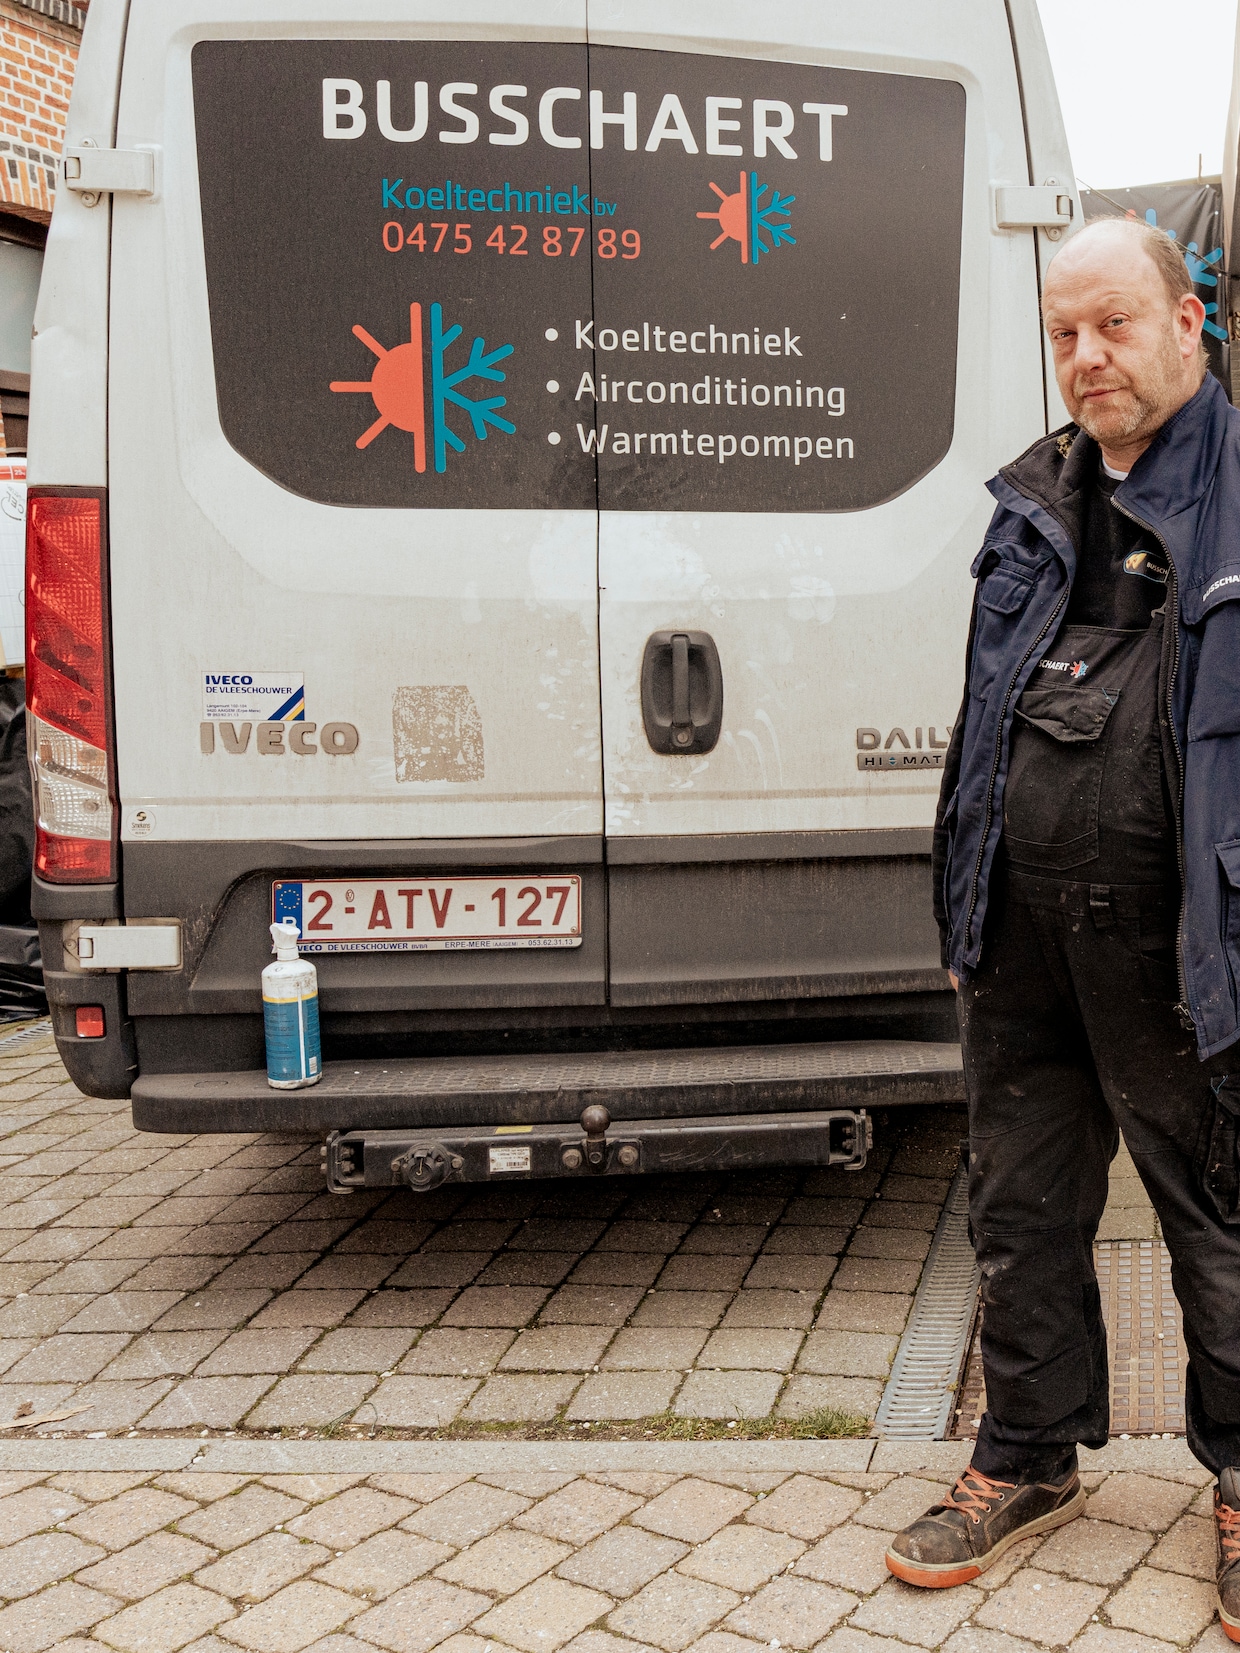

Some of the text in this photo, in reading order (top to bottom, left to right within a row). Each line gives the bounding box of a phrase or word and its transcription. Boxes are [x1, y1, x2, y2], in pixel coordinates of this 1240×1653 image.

[321, 77, 849, 162] BUSSCHAERT
[382, 177, 617, 217] Koeltechniek bv
[382, 220, 642, 260] 0475 42 87 89
[575, 320, 803, 358] Koeltechniek
[575, 372, 846, 417] Airconditioning
[576, 423, 855, 465] Warmtepompen
[1146, 561, 1168, 575] BUSSCH
[205, 675, 253, 685] IVECO
[1039, 659, 1070, 671] SCHAERT
[206, 686, 292, 694] DE VLEESCHOUWER
[200, 722, 360, 755] IVECO
[903, 755, 942, 765] MAT
[444, 941, 491, 949] ERPE-MERE
[527, 939, 574, 947] 053.62.31.13
